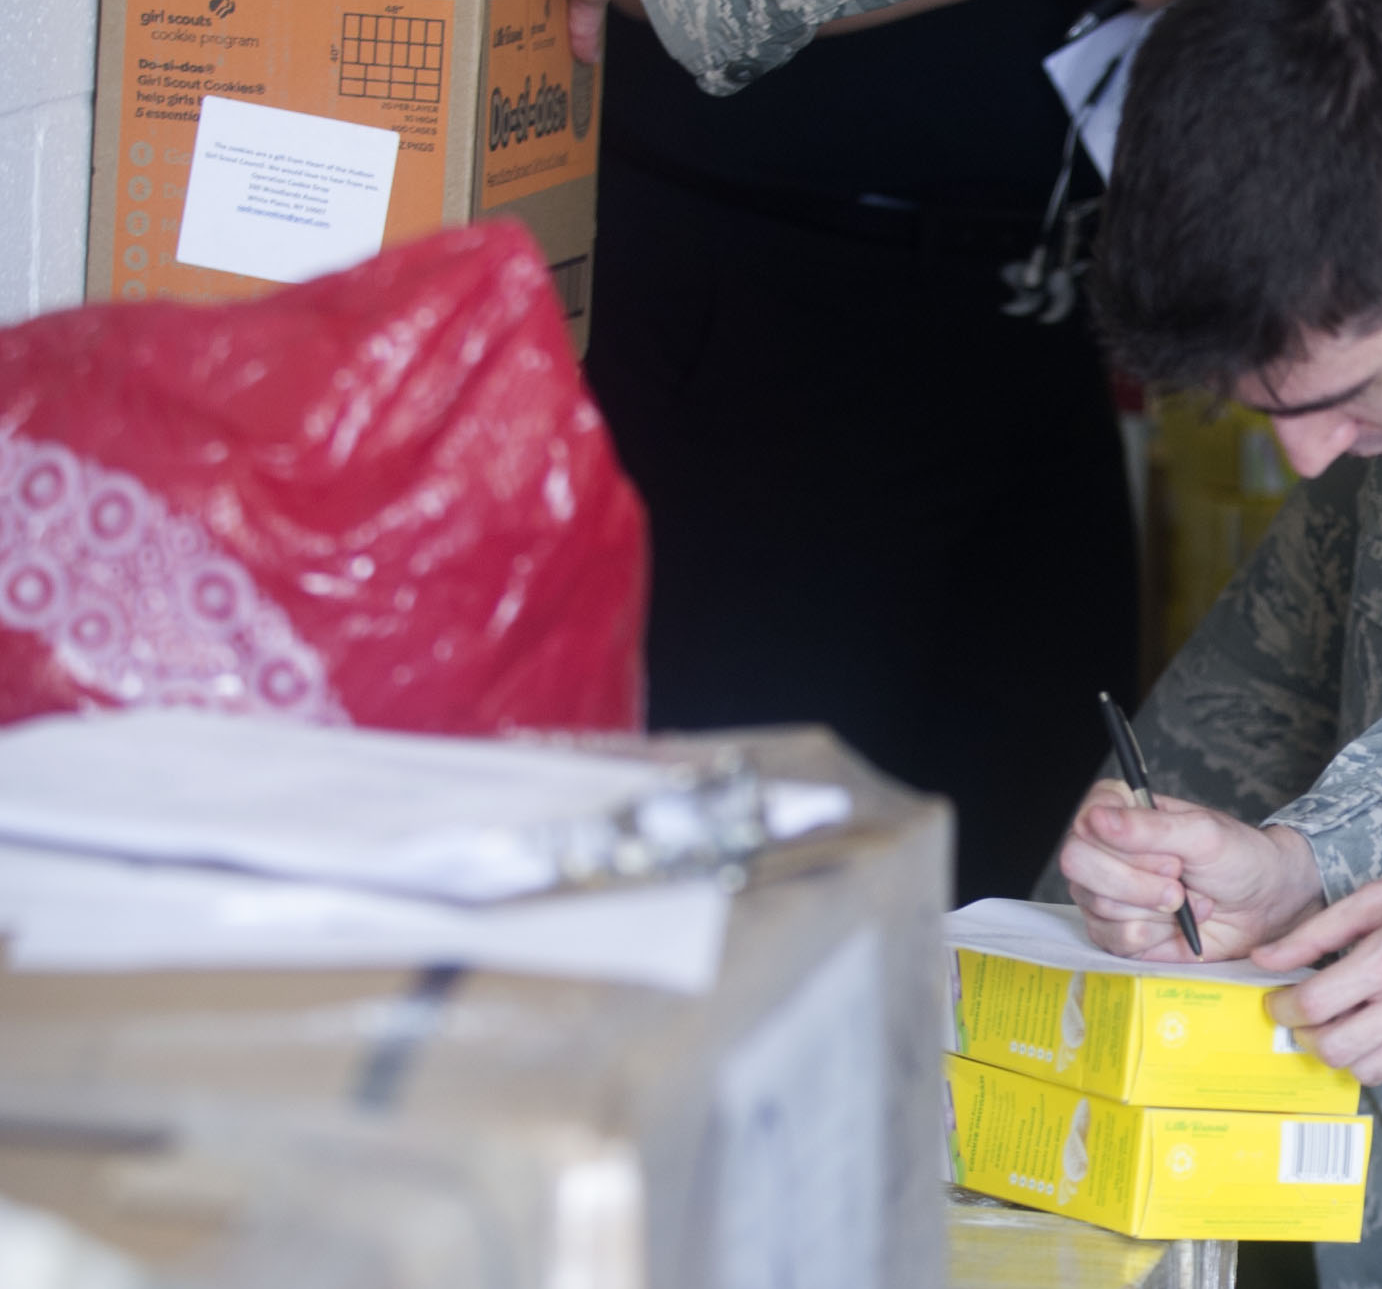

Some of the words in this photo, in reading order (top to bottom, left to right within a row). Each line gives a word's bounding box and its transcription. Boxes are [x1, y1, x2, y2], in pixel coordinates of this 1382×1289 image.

[140, 10, 165, 27] girl
[167, 15, 213, 27] scouts
[200, 33, 260, 50] program
[137, 74, 162, 87] Girl
[163, 76, 201, 91] Scout
[135, 90, 166, 106] help
[167, 93, 195, 107] girls
